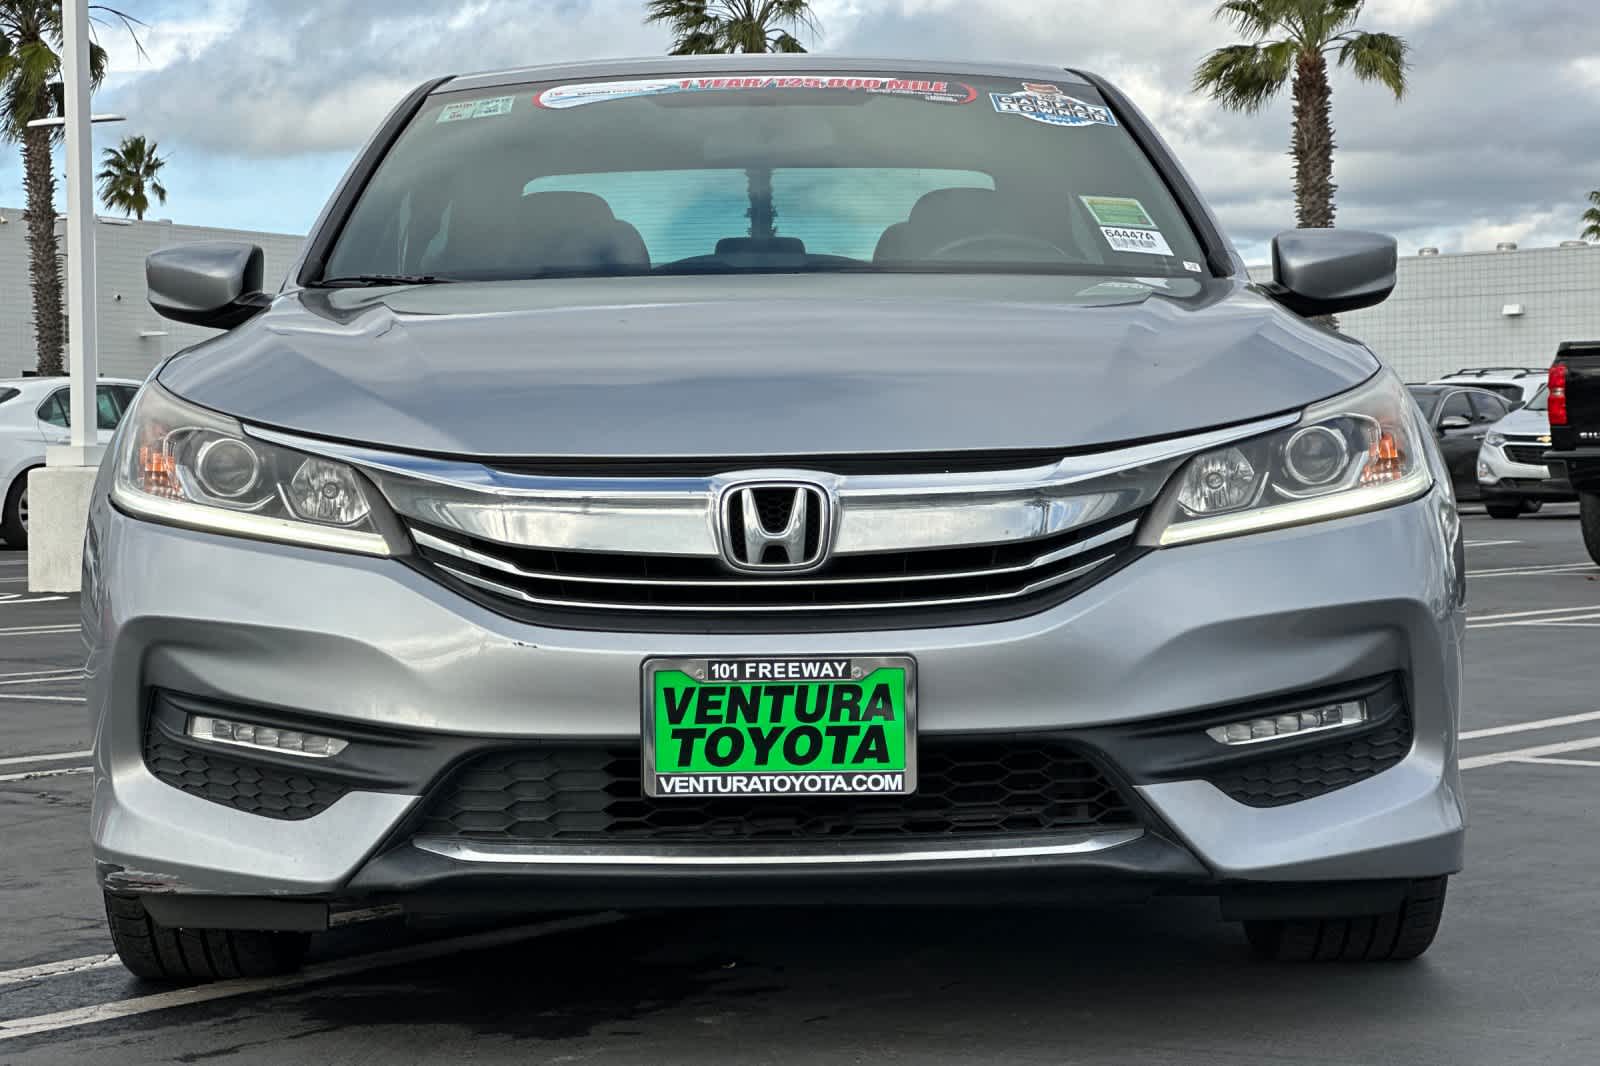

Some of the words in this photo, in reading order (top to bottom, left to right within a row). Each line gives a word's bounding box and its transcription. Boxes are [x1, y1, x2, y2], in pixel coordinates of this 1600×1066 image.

[887, 79, 948, 92] MILE
[1001, 95, 1104, 116] CARFAX
[1023, 104, 1108, 121] OWNER
[711, 663, 739, 679] 101
[745, 662, 847, 679] FREEWAY
[663, 683, 896, 725] VENTURA
[671, 725, 890, 768] TOYOTA
[659, 774, 903, 793] VENTURATOYOTA.COM
